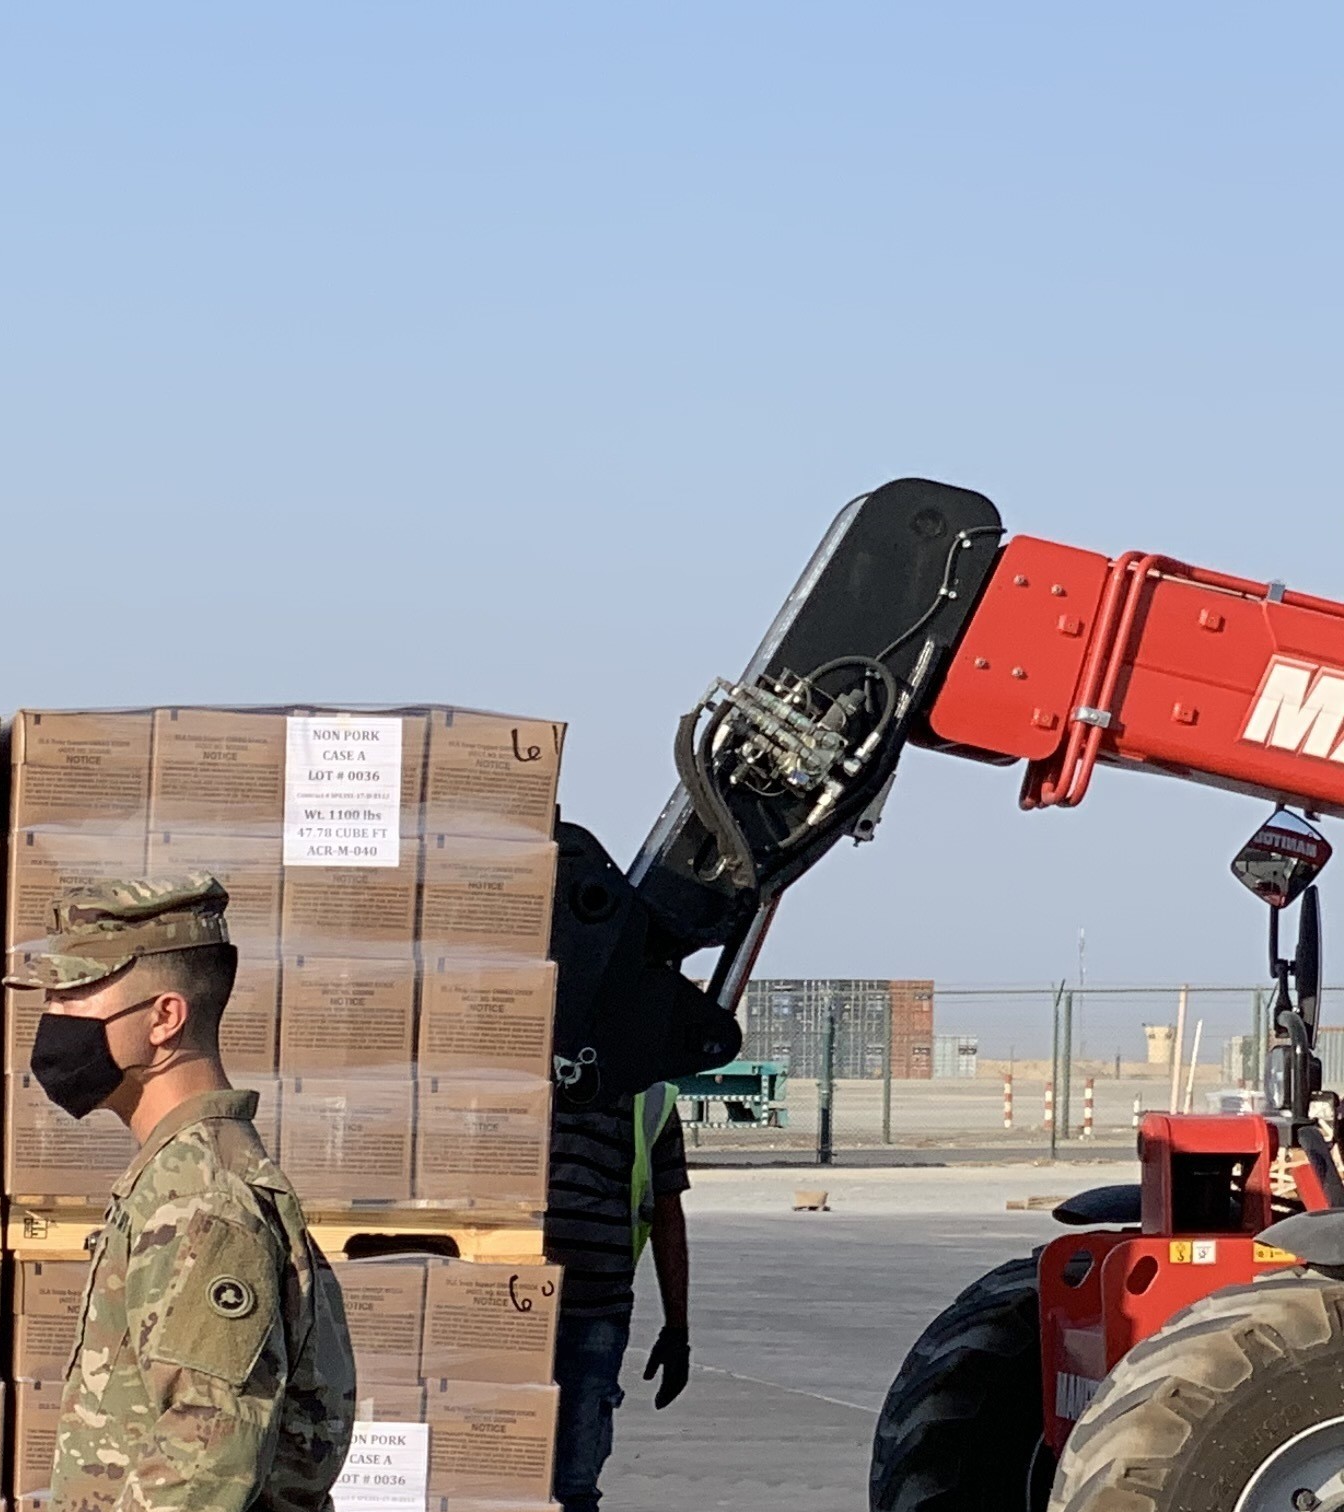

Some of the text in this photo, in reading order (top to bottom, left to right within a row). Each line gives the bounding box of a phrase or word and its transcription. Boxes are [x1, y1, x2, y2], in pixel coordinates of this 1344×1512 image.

[1239, 654, 1344, 764] M
[312, 730, 380, 743] NON PORK
[65, 755, 101, 765] NOTICE
[202, 751, 238, 761] NOTICE
[322, 750, 366, 762] CASE A
[308, 769, 380, 782] LOT # 0036
[329, 809, 360, 821] 1100
[362, 809, 382, 821] lbs
[297, 827, 387, 839] 47.78 CUBE FT
[307, 845, 377, 857] ACR-M-040
[468, 881, 504, 890] NOTICE
[469, 1004, 505, 1013] NOTICE
[343, 1302, 374, 1311] OTICE
[472, 1297, 509, 1307] NOTICE
[471, 1423, 507, 1433] NOTICE
[350, 1434, 406, 1446] ON PORK
[349, 1454, 393, 1466] CASE A
[363, 1475, 370, 1485] #
[373, 1474, 406, 1486] 0036
